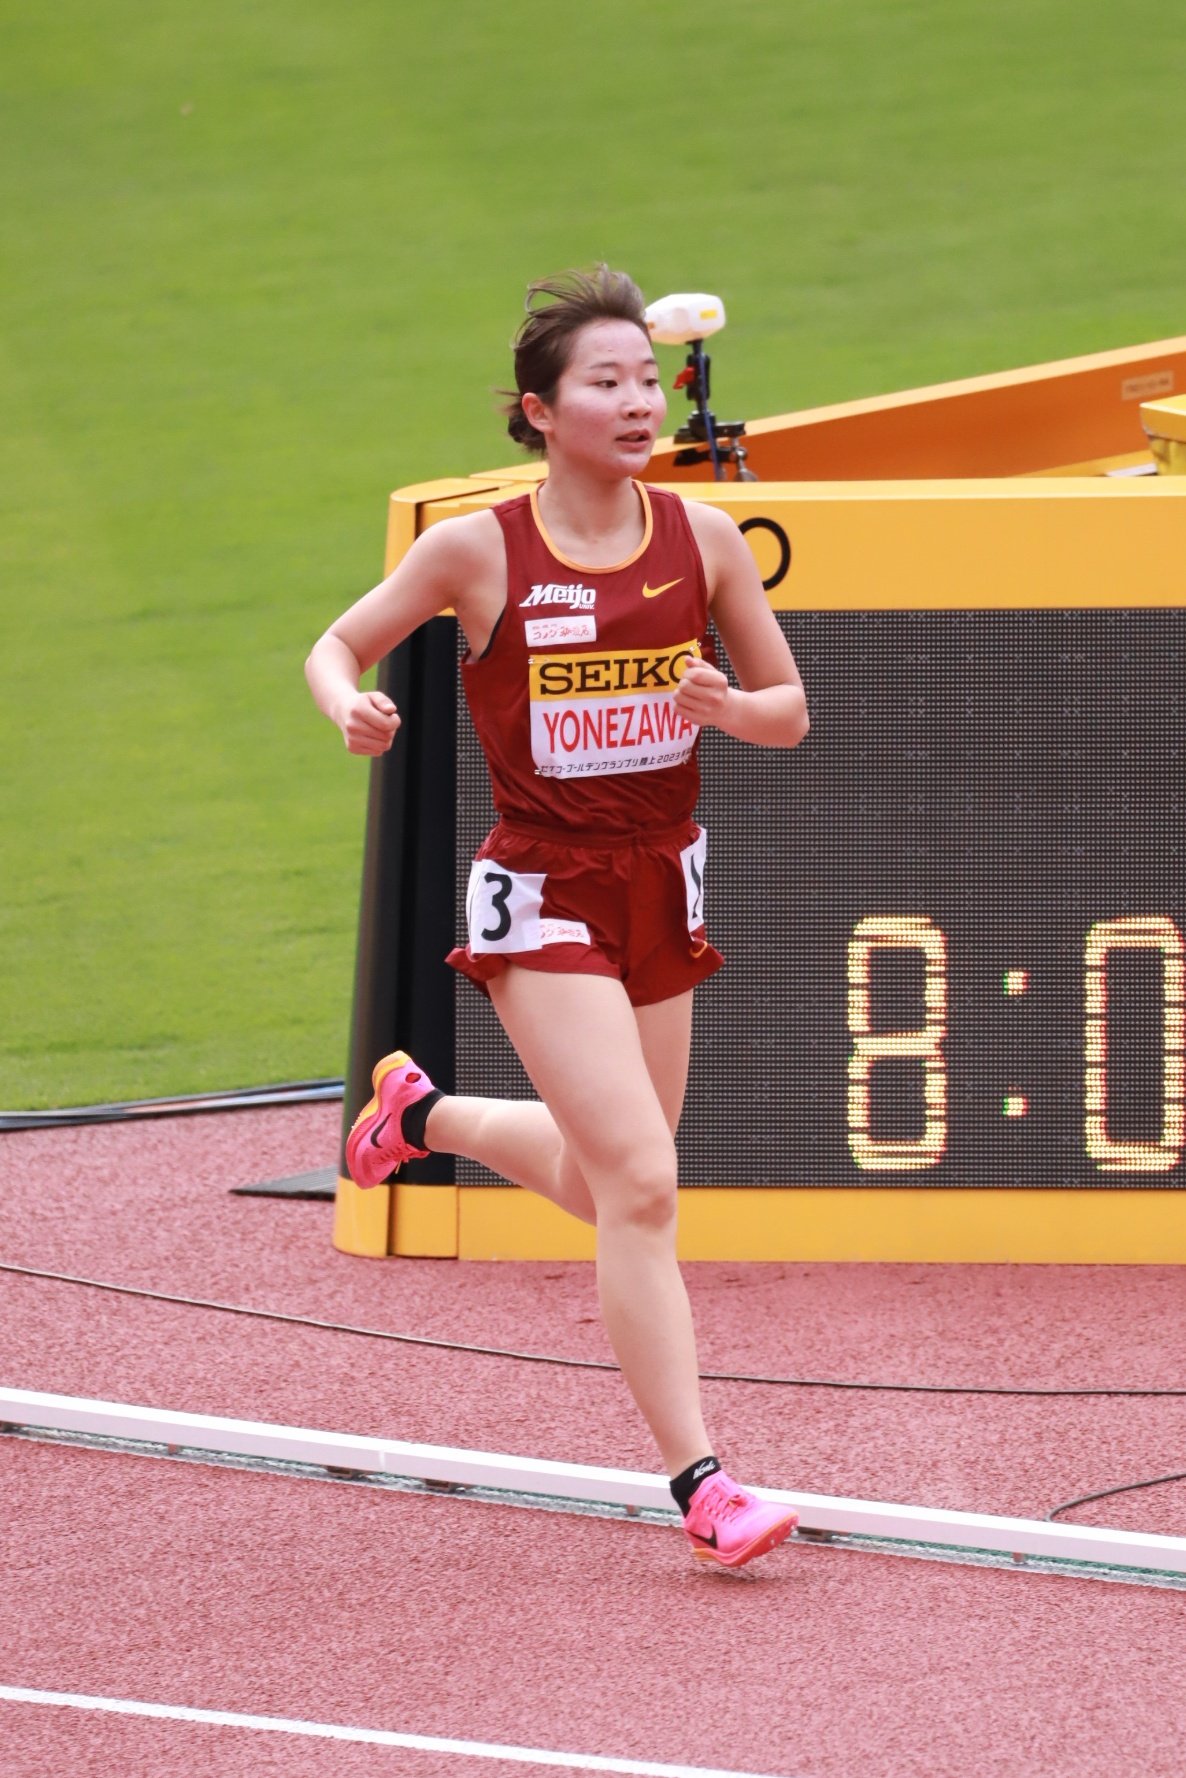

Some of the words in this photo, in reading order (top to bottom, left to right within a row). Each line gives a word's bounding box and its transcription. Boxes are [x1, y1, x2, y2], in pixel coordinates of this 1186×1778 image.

[518, 583, 596, 610] Meijo
[539, 650, 694, 695] SEIKO
[543, 702, 693, 753] YONEZAWA
[481, 872, 512, 942] 3
